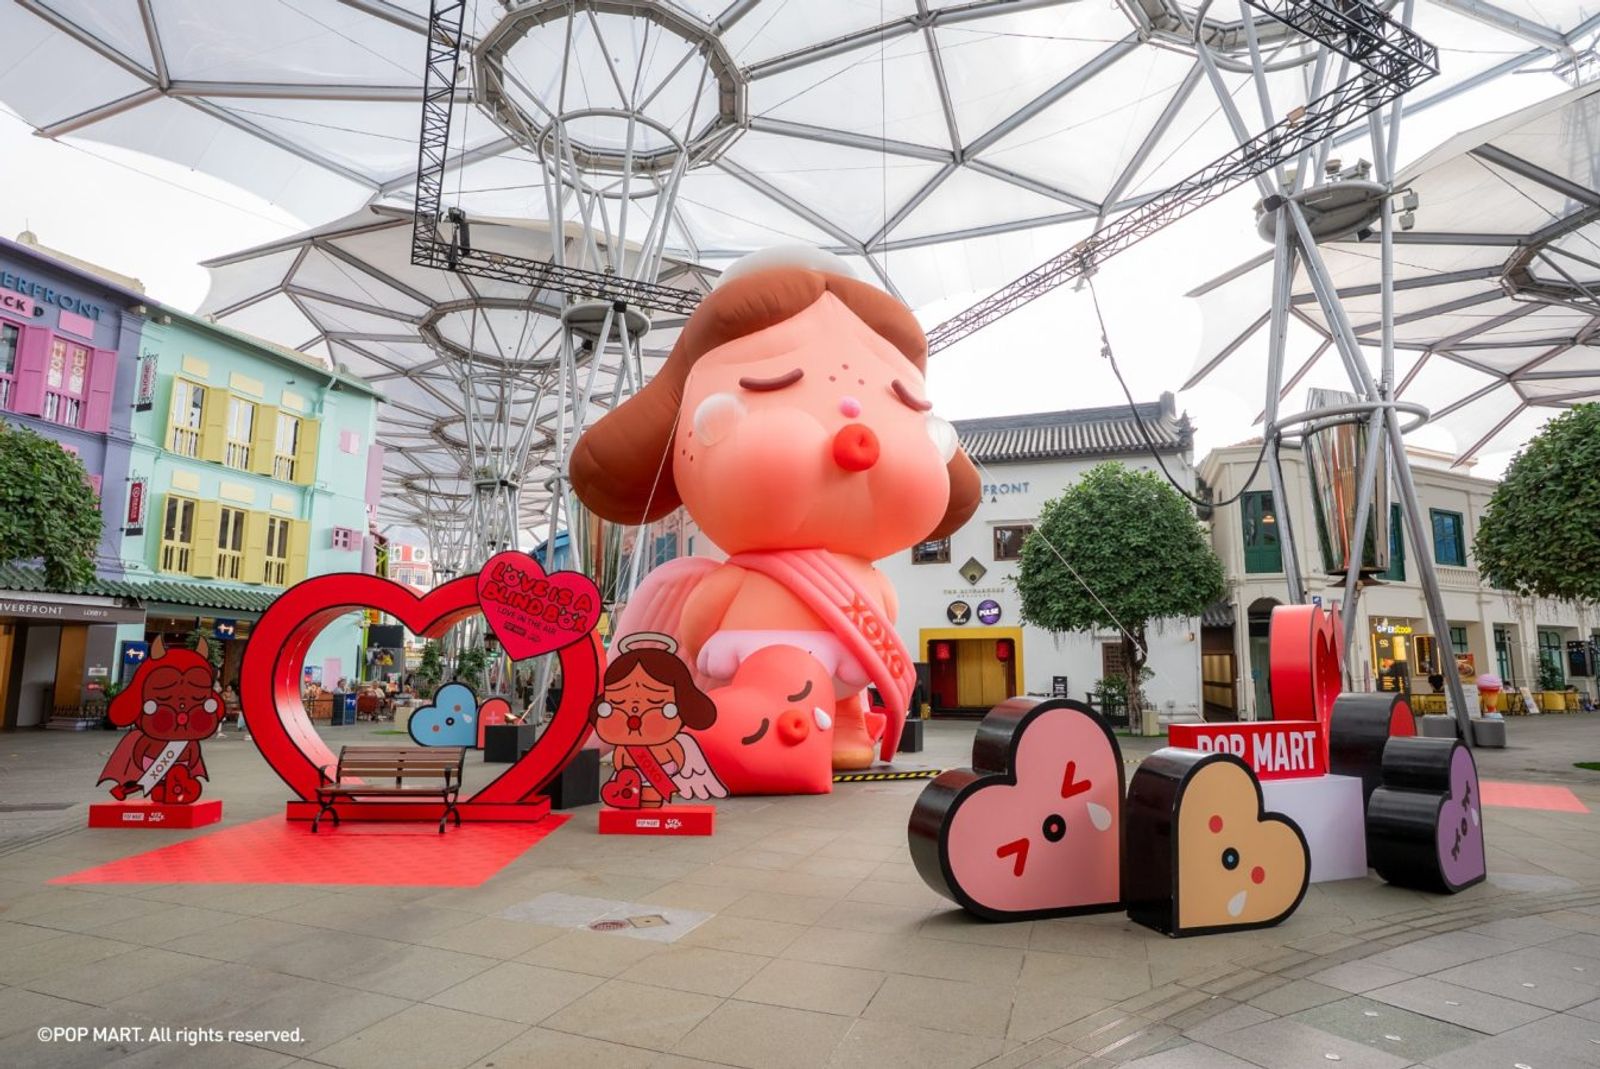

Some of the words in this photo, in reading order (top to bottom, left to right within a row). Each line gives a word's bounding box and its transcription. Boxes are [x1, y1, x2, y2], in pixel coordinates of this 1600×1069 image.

[481, 581, 543, 615] BLIND
[491, 562, 548, 597] LOVE
[574, 594, 592, 613] A
[150, 751, 174, 779] XOXO
[1252, 731, 1317, 773] MART
